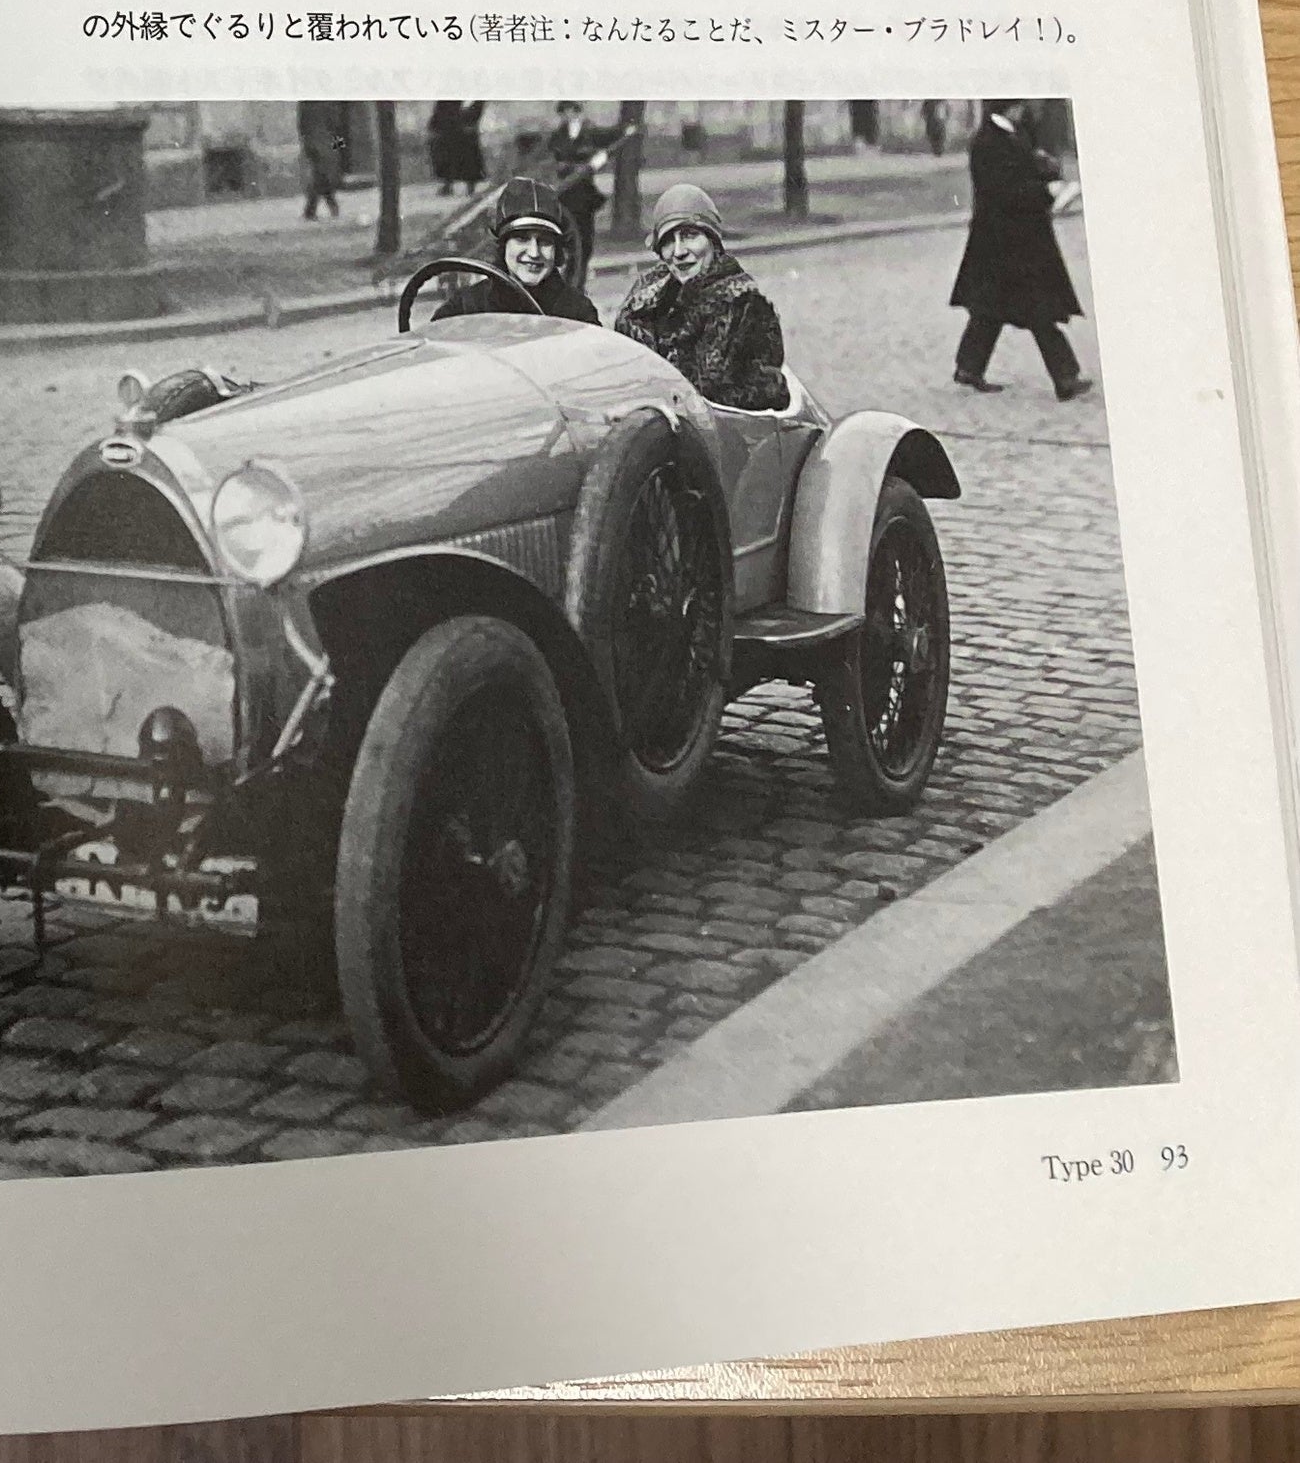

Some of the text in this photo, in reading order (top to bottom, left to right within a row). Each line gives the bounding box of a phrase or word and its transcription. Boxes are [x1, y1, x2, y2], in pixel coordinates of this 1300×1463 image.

[1041, 1145, 1188, 1182] Type 30 93
